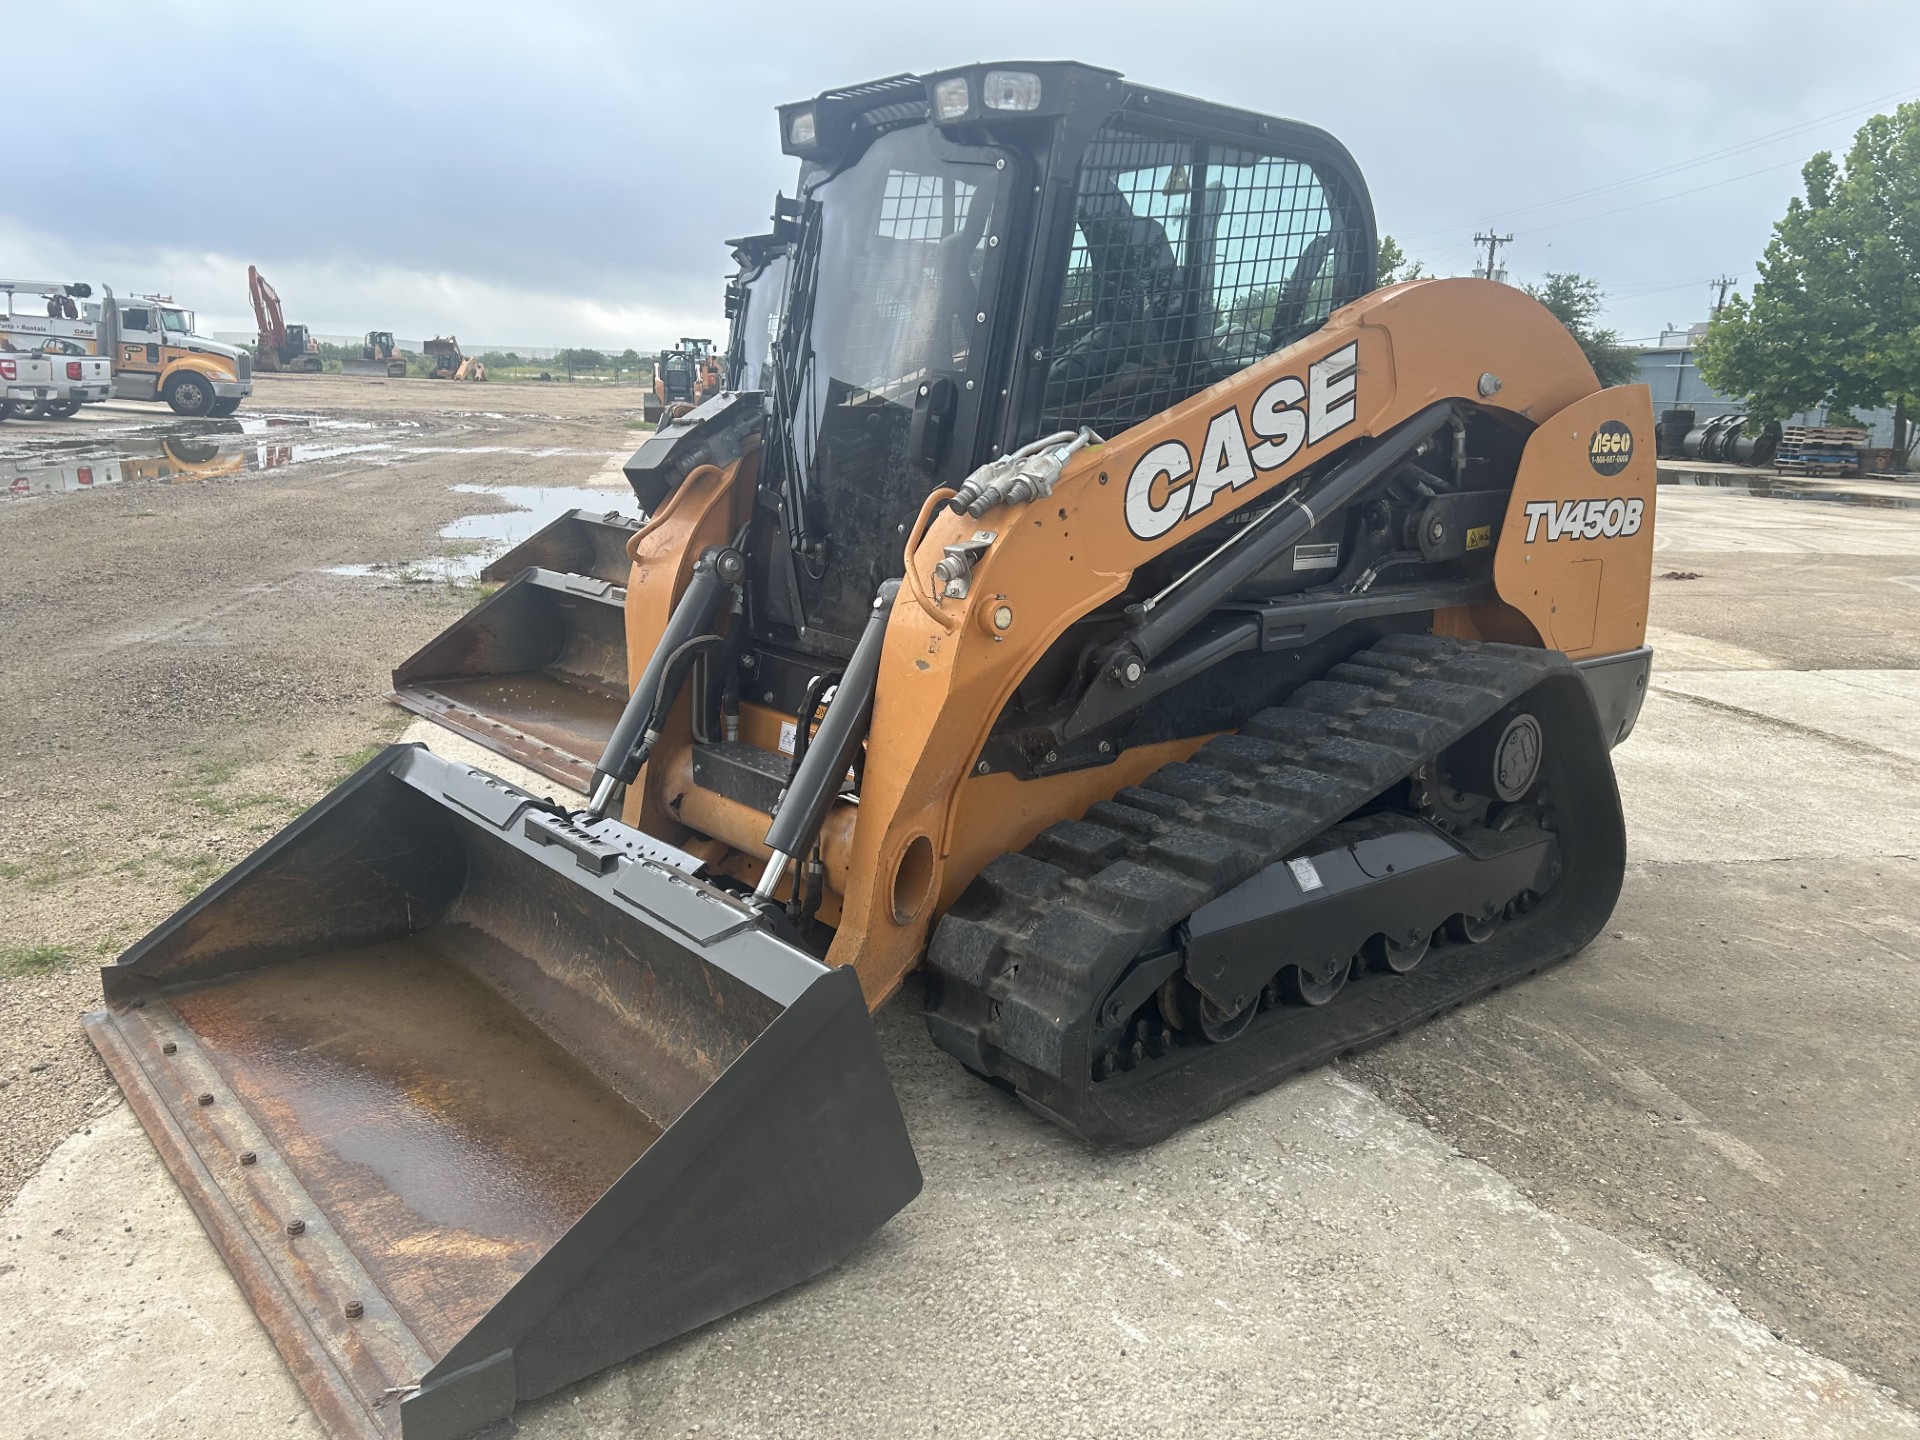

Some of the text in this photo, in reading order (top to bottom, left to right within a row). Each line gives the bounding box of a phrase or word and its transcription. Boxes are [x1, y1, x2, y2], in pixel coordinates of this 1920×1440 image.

[22, 324, 47, 332] Rentals
[1124, 339, 1358, 541] CASE
[1592, 432, 1631, 453] ASCO
[1524, 497, 1645, 543] TV450B
